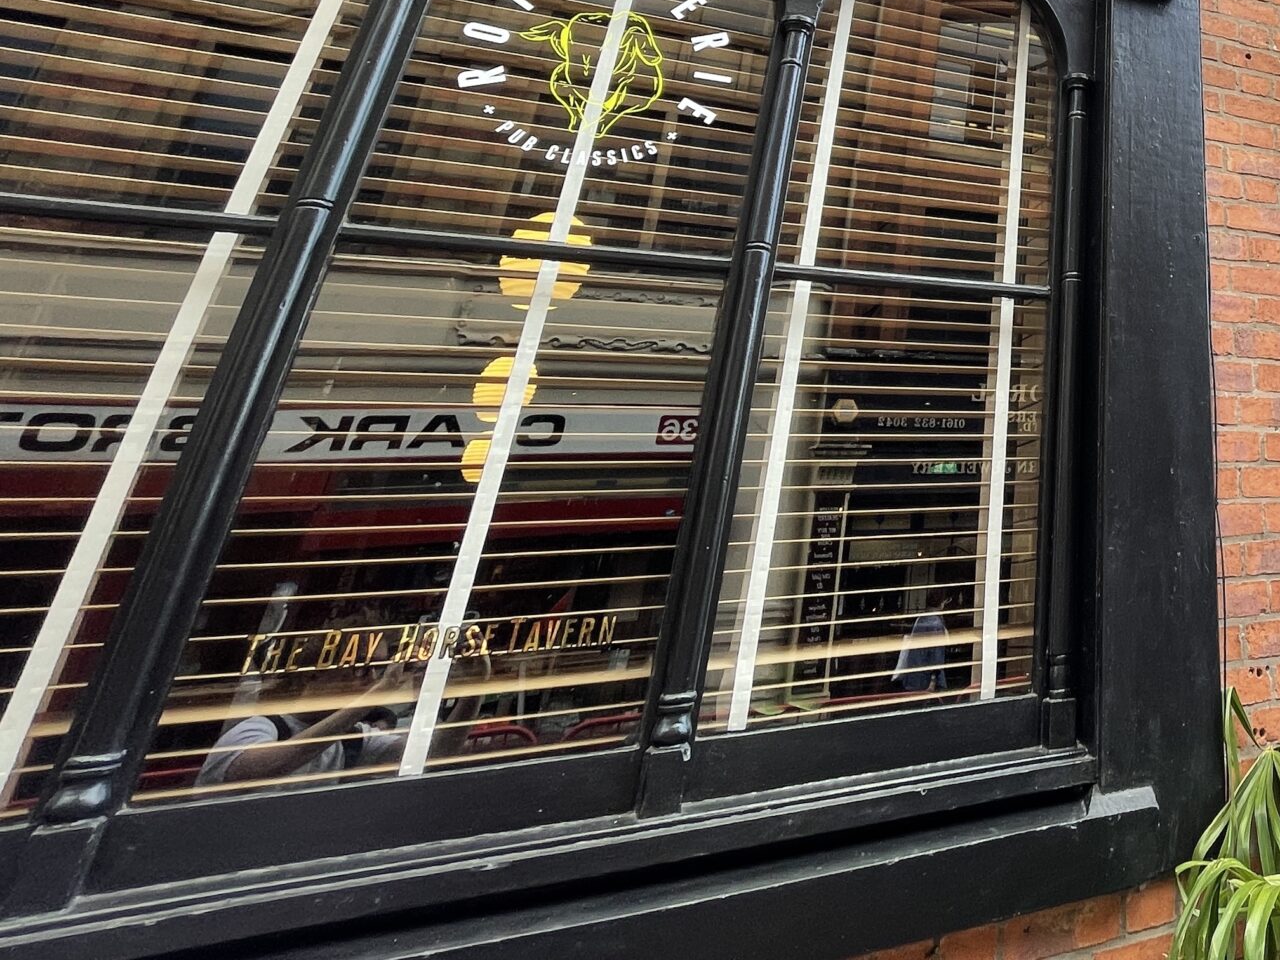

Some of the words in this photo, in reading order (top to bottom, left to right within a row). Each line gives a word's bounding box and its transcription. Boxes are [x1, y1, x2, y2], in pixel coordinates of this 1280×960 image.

[494, 120, 538, 152] PUB
[545, 140, 658, 167] CLASSICS
[241, 634, 308, 675] THE
[316, 629, 384, 670] BAY
[392, 623, 497, 664] HORSE
[506, 616, 618, 653] TAVERN
